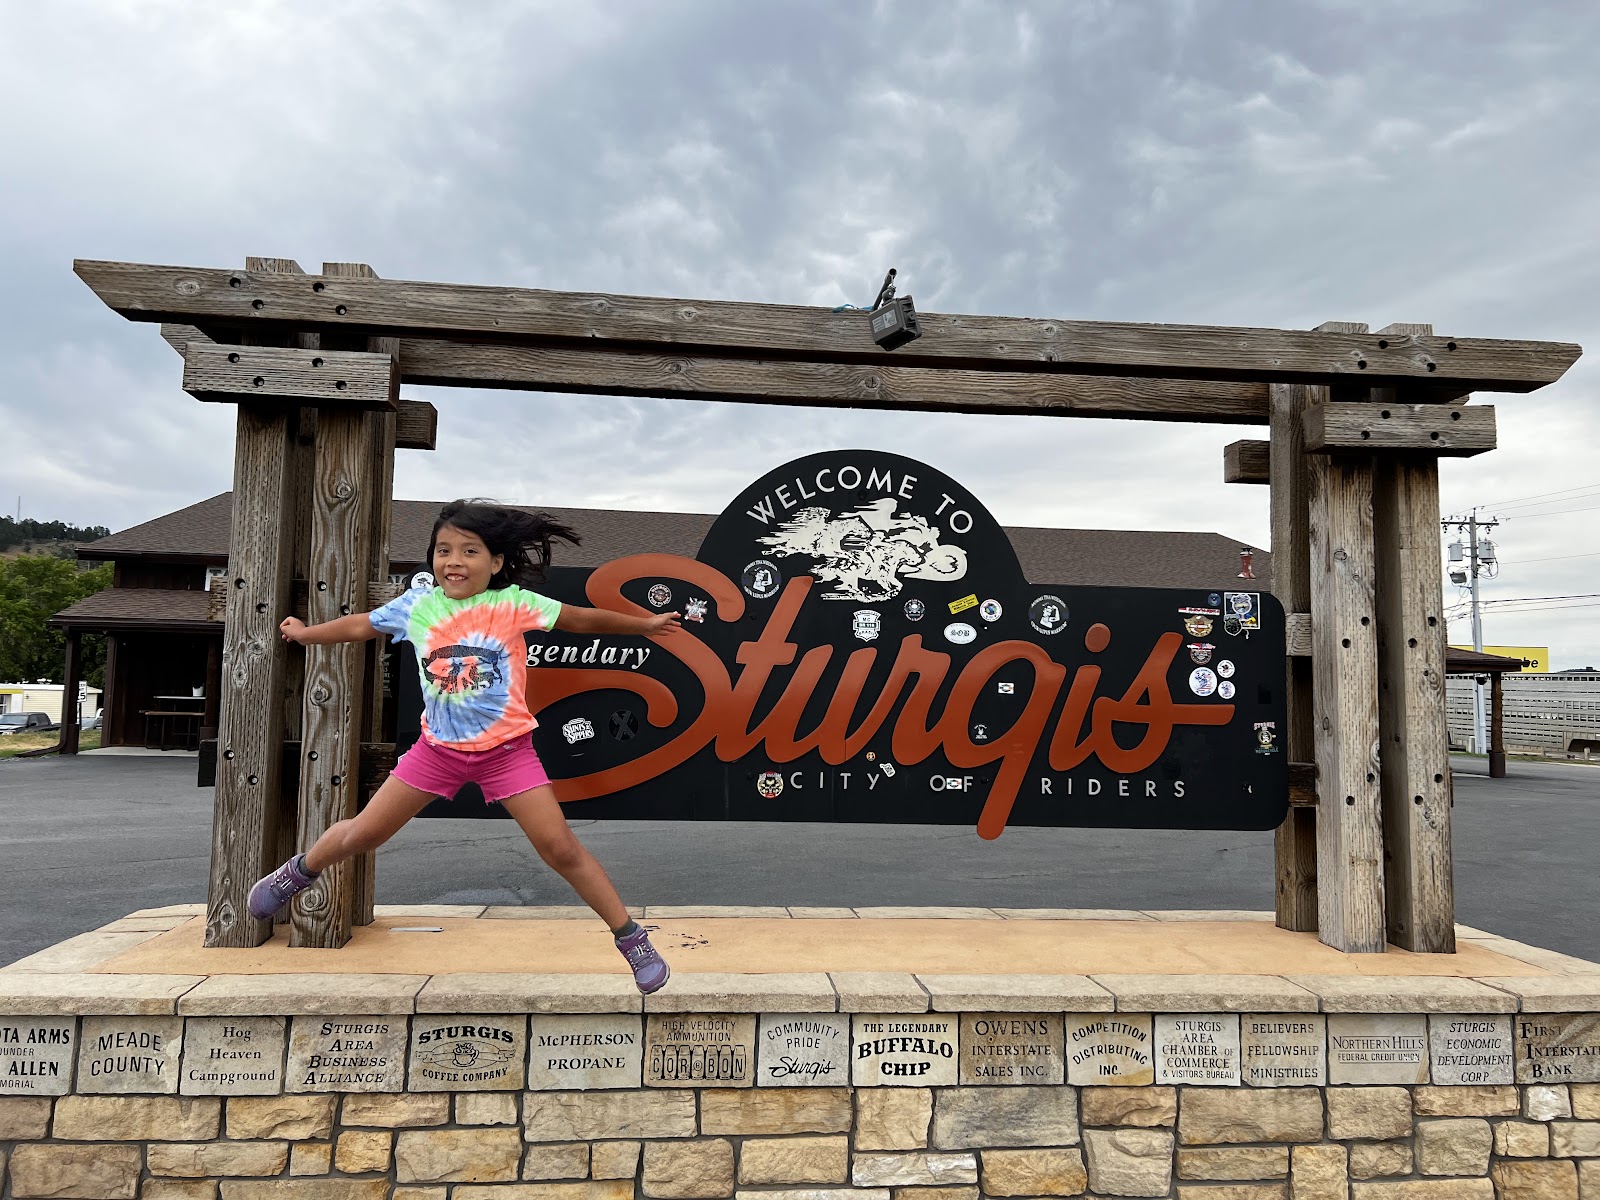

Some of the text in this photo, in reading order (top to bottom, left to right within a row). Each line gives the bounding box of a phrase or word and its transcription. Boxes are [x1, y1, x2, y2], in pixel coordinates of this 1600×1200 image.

[746, 466, 973, 534] WELCOME TO
[526, 639, 651, 670] gendary
[526, 555, 1235, 840] Sturgis
[790, 771, 1185, 798] CITY OF RIDERS
[321, 1022, 390, 1036] STURGIS
[662, 1021, 737, 1031] HIGH VELOCITY
[766, 1022, 840, 1041] COMMUNITY
[864, 1023, 949, 1033] THE LEGENDARY
[975, 1020, 1048, 1036] OWENS
[1072, 1022, 1147, 1042] COMPETITION
[1175, 1021, 1222, 1032] STURGIS
[1252, 1023, 1314, 1034] BELIEVERS
[1450, 1022, 1496, 1033] STURGIS
[1520, 1023, 1562, 1038] FIRST
[27, 1028, 70, 1044] ARMS
[222, 1026, 252, 1041] Hog
[418, 1025, 514, 1044] STURGIS
[538, 1034, 636, 1047] McPHERSON
[666, 1032, 732, 1042] AMMUNITION
[1183, 1033, 1215, 1043] AREA
[98, 1031, 162, 1052] MEADE
[328, 1039, 374, 1051] AREA
[786, 1038, 821, 1049] PRIDE
[857, 1036, 954, 1060] BUFFALO
[1333, 1036, 1424, 1049] NORTHERN HILLS
[1447, 1038, 1502, 1049] ECONOMIC
[209, 1047, 262, 1060] Heaven
[972, 1045, 1052, 1056] INTERSTATE
[1072, 1044, 1148, 1065] DISTRIBUTING
[1162, 1045, 1234, 1057] CHAMBER OF
[1248, 1045, 1319, 1056] FELLOWSHIP
[1338, 1053, 1420, 1061] FEDERAL CREDIT UNION
[1526, 1044, 1600, 1059] INTERSTAT
[91, 1057, 165, 1077] COUNTY
[308, 1055, 388, 1069] BUSINESS
[547, 1057, 626, 1070] PROPANE
[768, 1056, 836, 1079] Sturgis
[1166, 1058, 1230, 1068] COMMERCE
[1437, 1055, 1512, 1066] DEVELOPMENT
[9, 1061, 59, 1076] ALLEN
[422, 1066, 508, 1082] COFFEE COMPANY
[880, 1061, 932, 1076] CHIP
[975, 1066, 1048, 1077] SALES INC.
[1099, 1064, 1122, 1076] INC.
[1162, 1069, 1235, 1079] & VISITORS BUREAU
[1250, 1068, 1319, 1078] MINISTRIES
[1533, 1064, 1573, 1078] BANK
[189, 1069, 276, 1084] Campground
[302, 1071, 386, 1085] ALLIANCE
